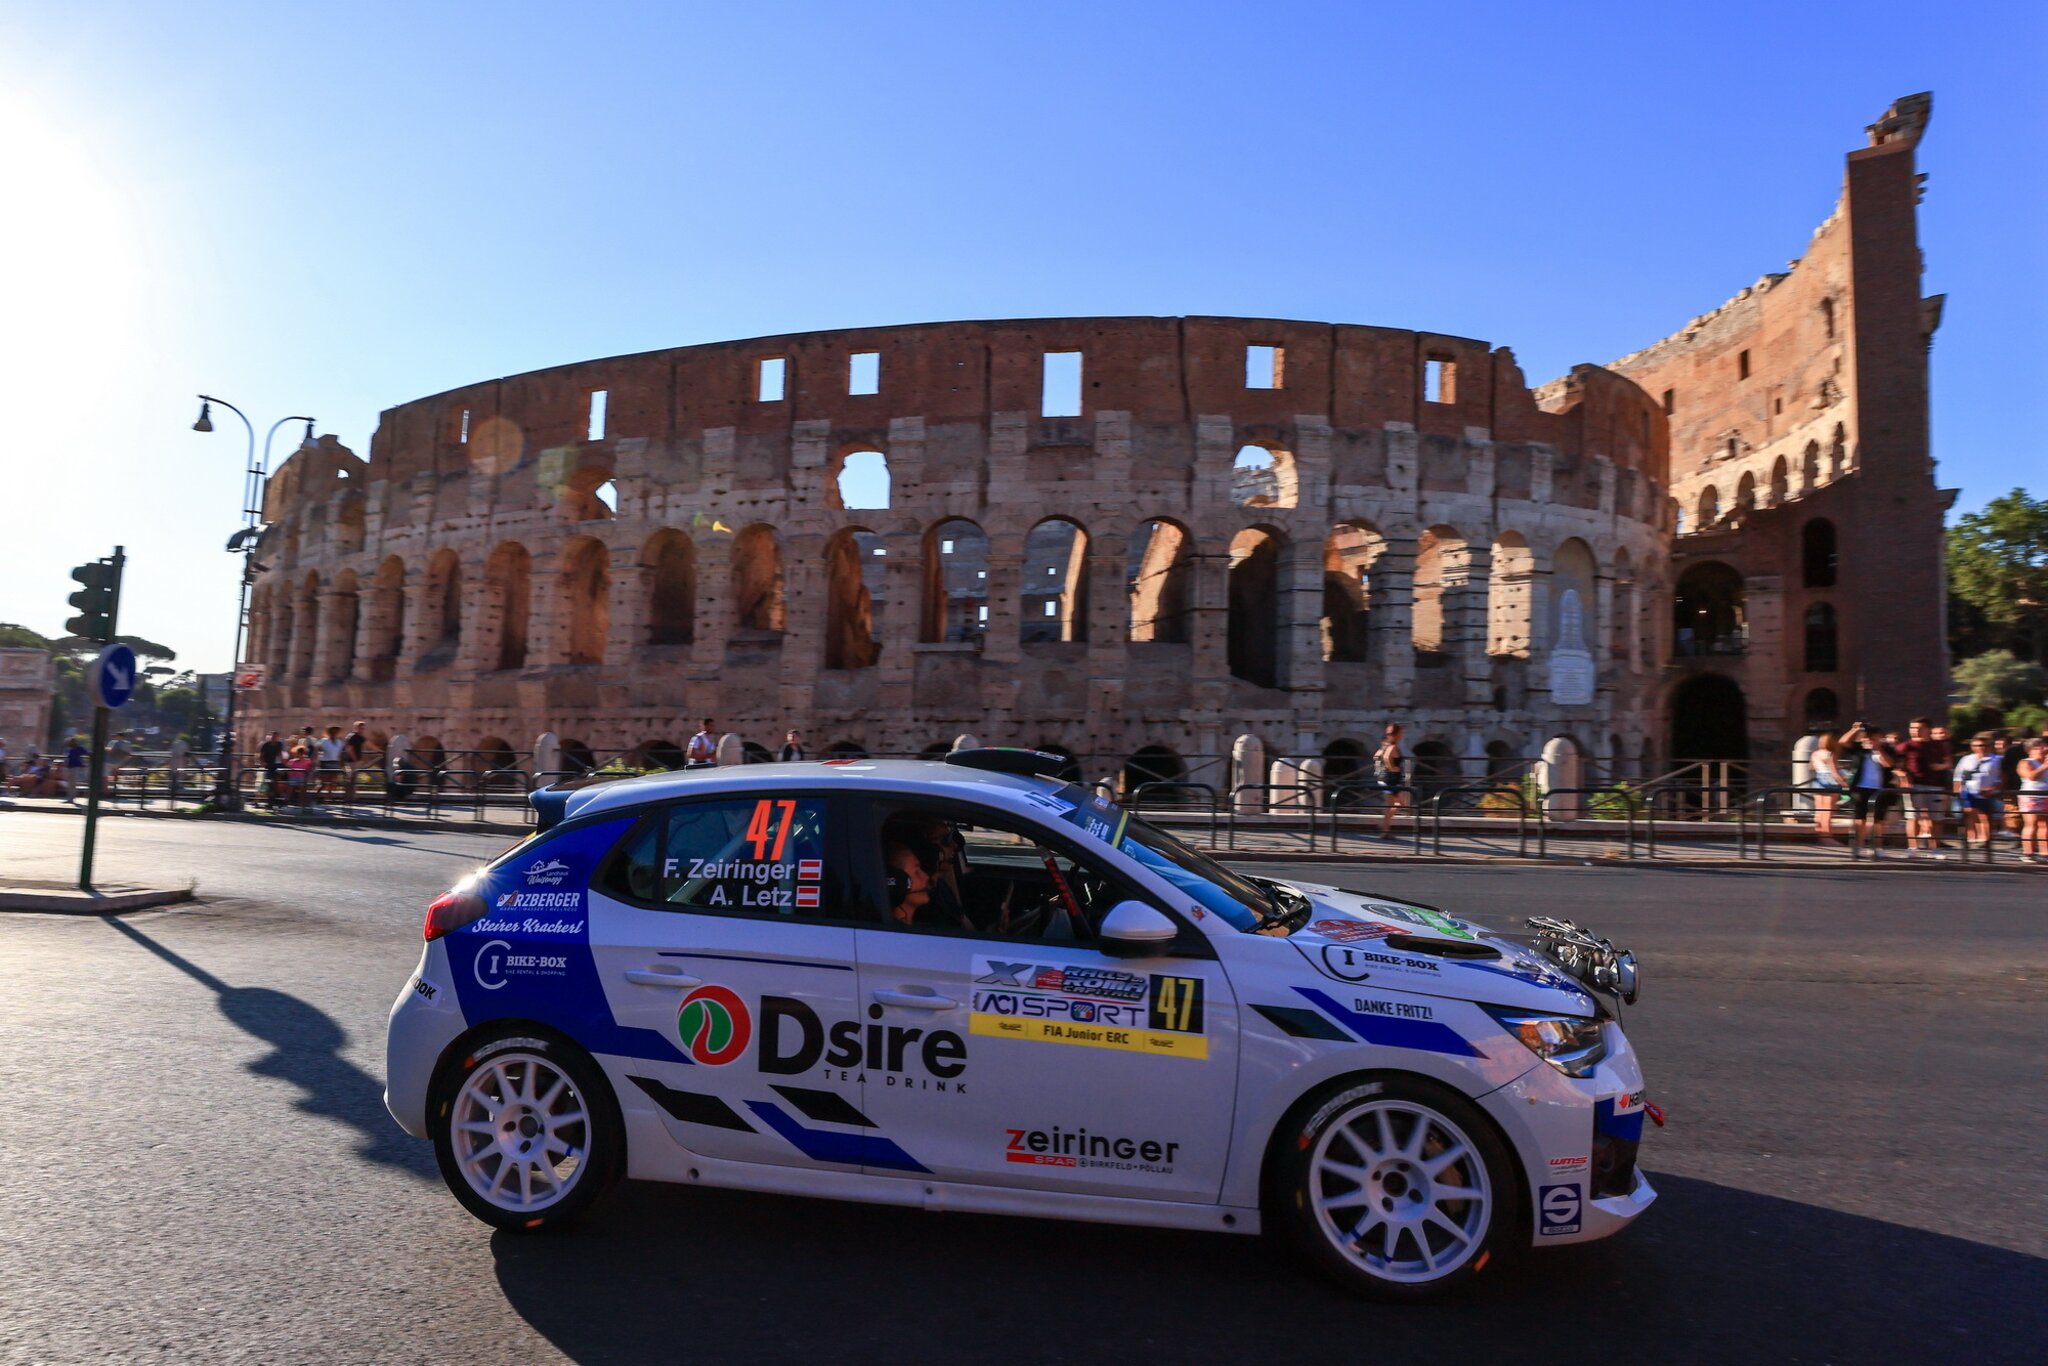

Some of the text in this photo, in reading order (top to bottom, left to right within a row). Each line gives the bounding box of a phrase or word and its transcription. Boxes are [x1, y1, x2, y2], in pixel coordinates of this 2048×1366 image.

[745, 800, 797, 861] 47
[663, 858, 796, 885] F. Zeiringer
[709, 884, 793, 907] A. Letz
[522, 918, 584, 934] Kracherl
[506, 955, 567, 968] BIKE-BOX
[1363, 952, 1440, 971] BIKE-BOX
[1022, 996, 1145, 1026] SPORT
[1157, 977, 1195, 1031] 47
[1354, 998, 1433, 1020] DANKE FRITZ!
[758, 994, 968, 1079] Dsire
[1043, 1025, 1130, 1044] FIA Junior ERC
[824, 1069, 967, 1094] TEA DRINK
[1034, 1155, 1077, 1167] SPAR
[1089, 1160, 1132, 1171] BIRKFELD
